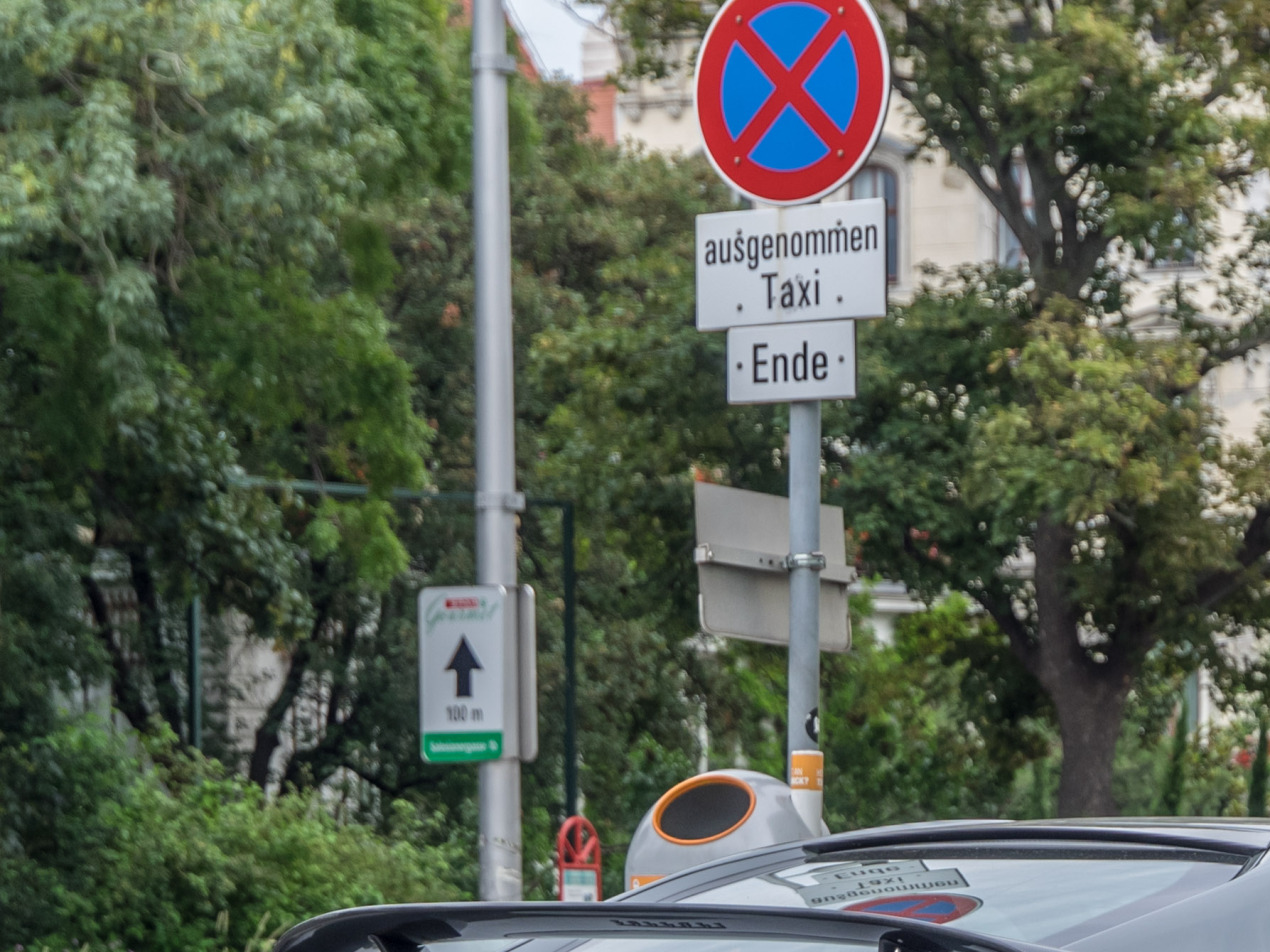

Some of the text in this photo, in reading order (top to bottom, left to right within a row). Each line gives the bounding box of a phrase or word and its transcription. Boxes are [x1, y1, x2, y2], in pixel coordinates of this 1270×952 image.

[704, 223, 878, 270] ausgenommen
[761, 269, 821, 310] Taxi
[752, 341, 829, 384] Ende
[446, 705, 483, 722] 100 m
